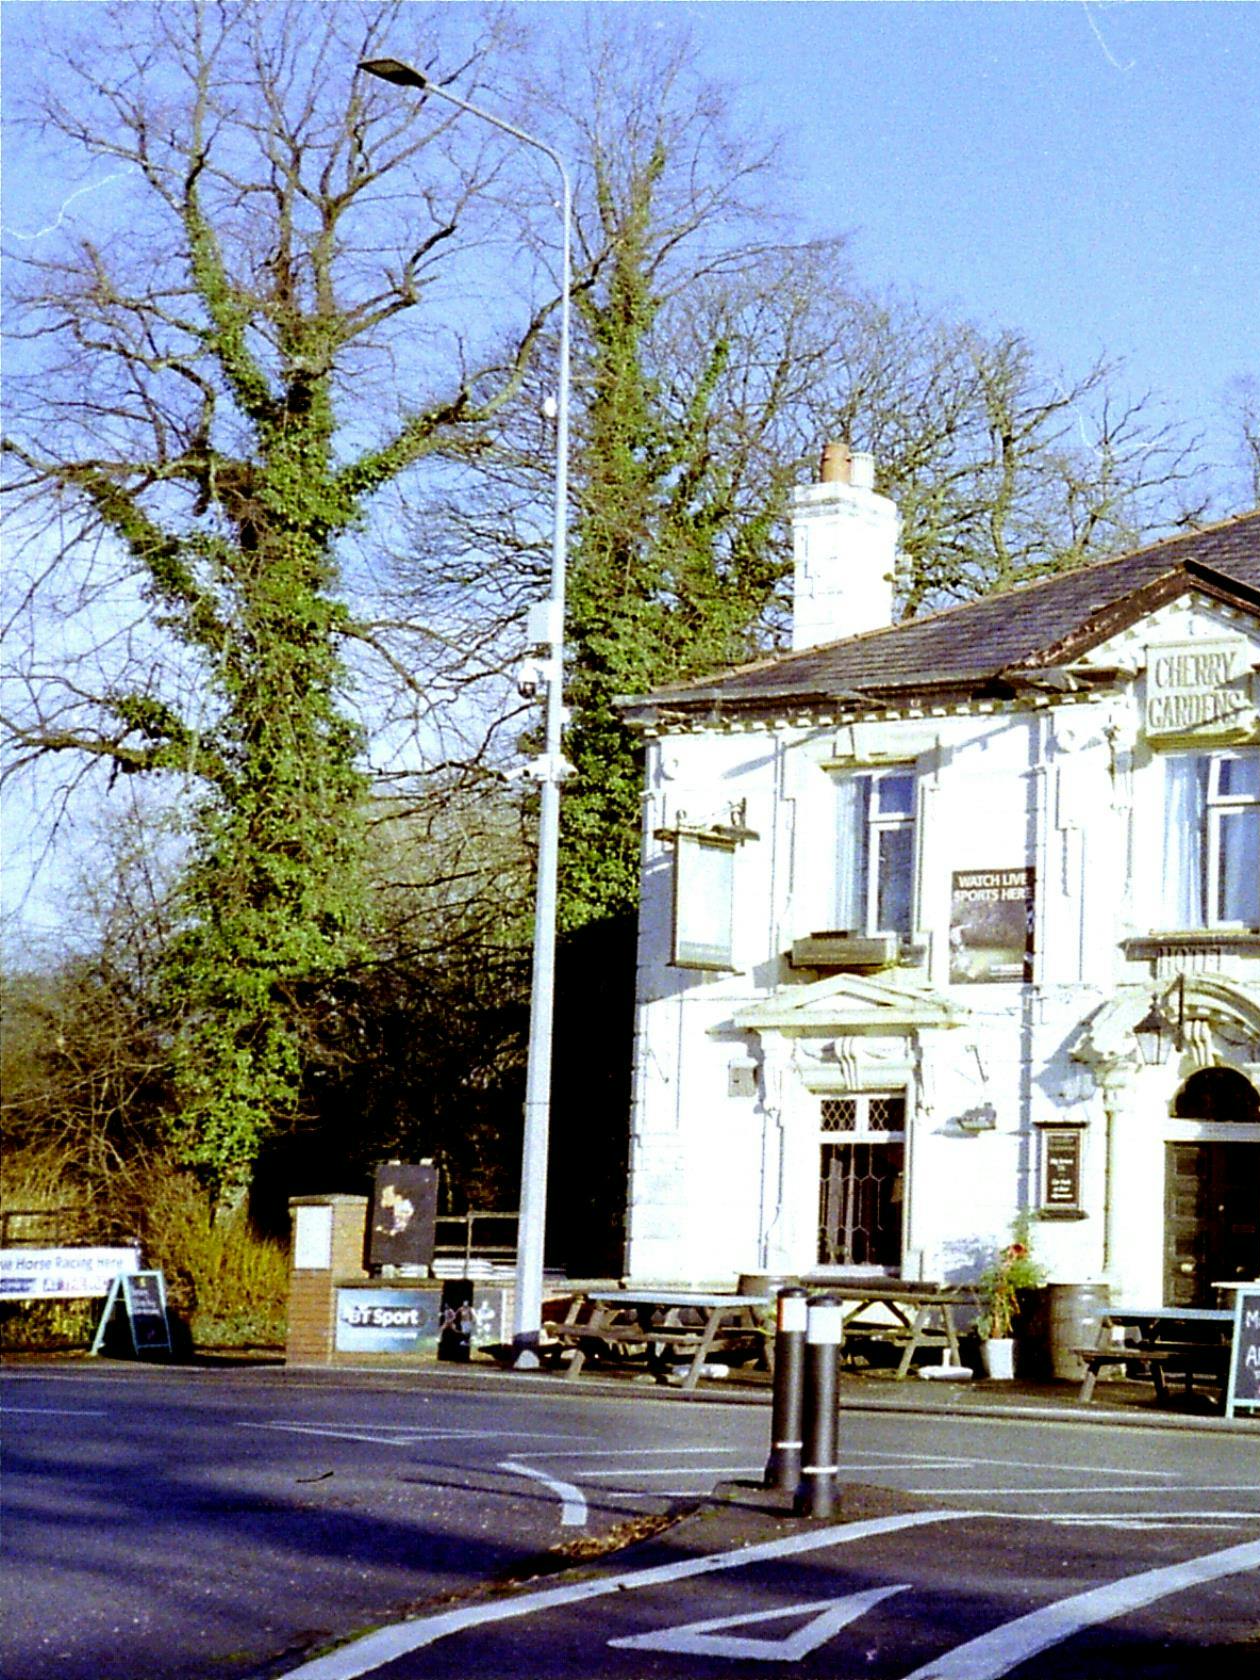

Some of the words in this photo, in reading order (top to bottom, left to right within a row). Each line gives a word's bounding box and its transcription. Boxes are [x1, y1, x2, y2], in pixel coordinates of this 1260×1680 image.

[1155, 651, 1237, 688] CHERRY
[1149, 690, 1247, 728] GARDENS
[958, 873, 999, 888] WATCH
[1002, 872, 1026, 886] LIVE
[953, 888, 999, 902] SPORTS
[1001, 887, 1034, 901] HERE
[16, 1257, 51, 1271] Horse
[56, 1256, 93, 1272] Racing
[348, 1307, 371, 1325] BT
[373, 1308, 419, 1327] Sport
